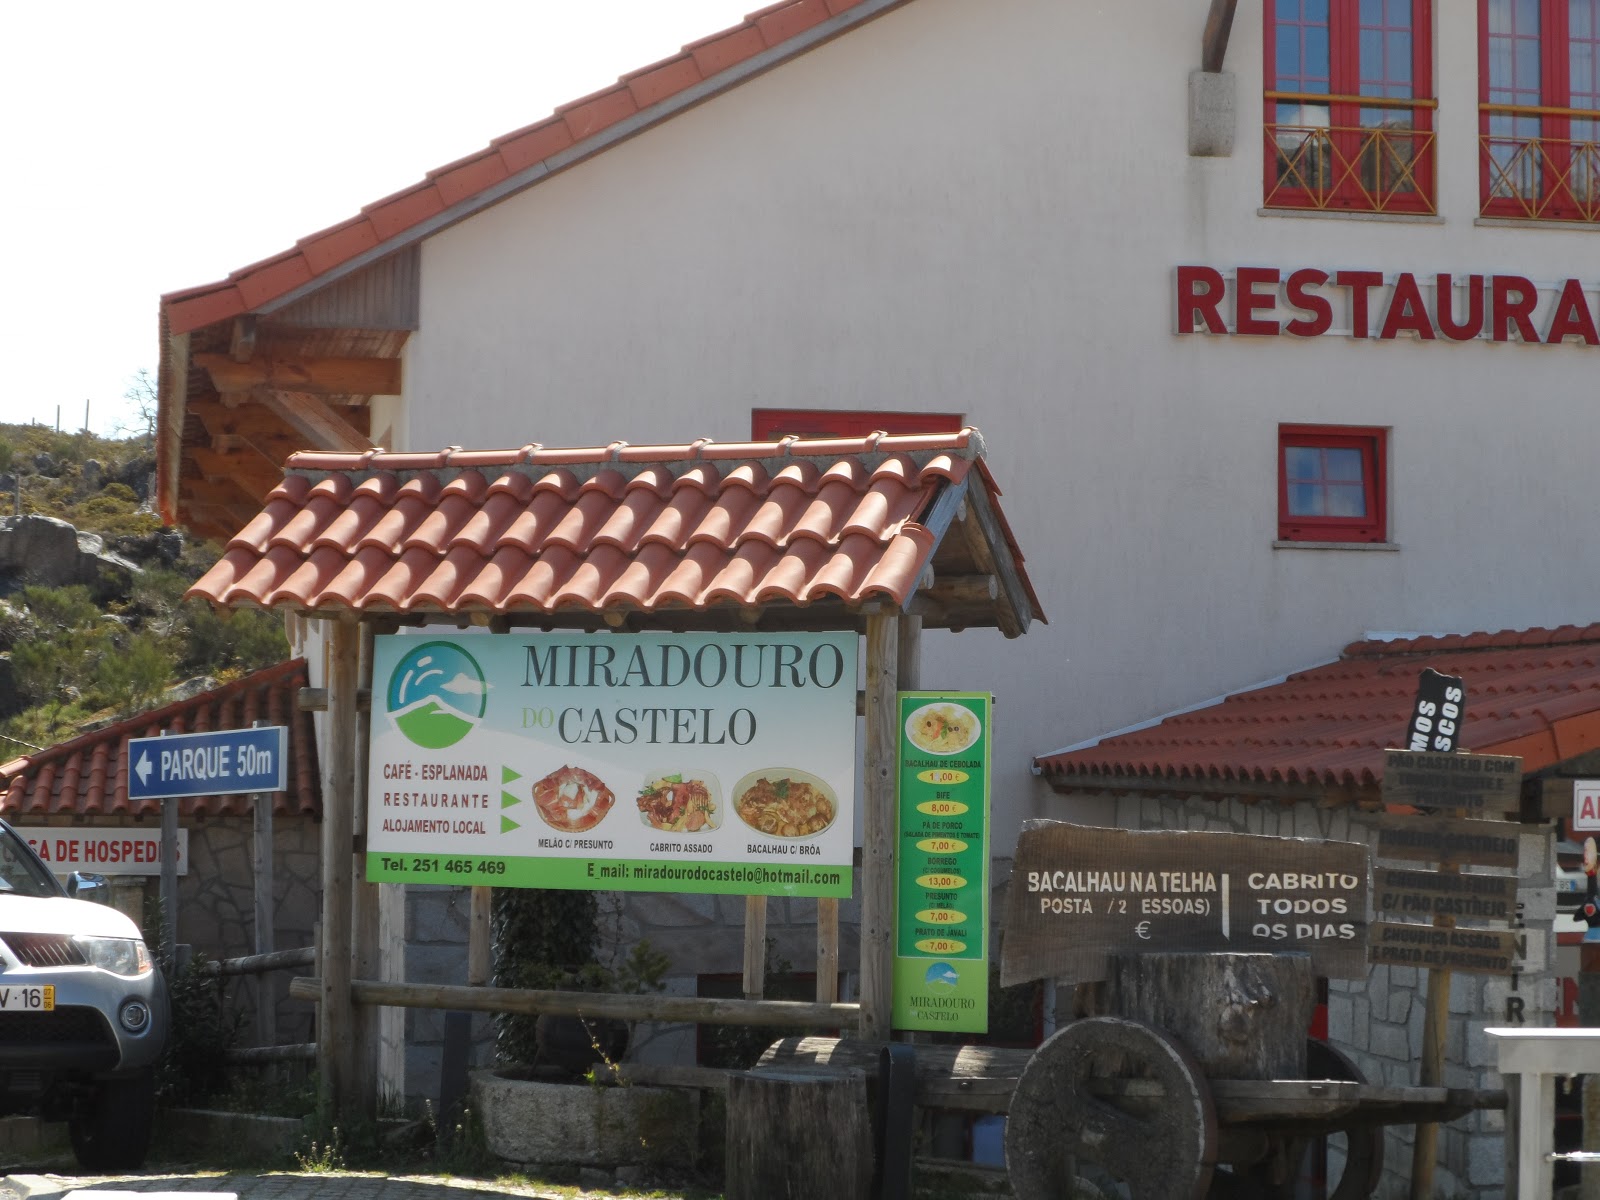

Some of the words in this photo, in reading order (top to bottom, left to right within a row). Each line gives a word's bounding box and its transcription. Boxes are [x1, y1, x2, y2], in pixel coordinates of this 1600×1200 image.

[1177, 265, 1600, 345] RESTAURA
[520, 643, 844, 688] MIRADOURO
[521, 707, 555, 729] DO
[557, 707, 757, 745] CASTELO
[161, 745, 230, 782] PARQUE
[237, 744, 272, 777] 50m
[383, 760, 412, 780] CAFÉ
[421, 764, 488, 781] ESPLANADA
[1484, 760, 1515, 774] COM
[383, 792, 488, 809] RESTAURANTE
[935, 791, 950, 799] BIFE
[931, 803, 950, 813] 8,00
[382, 819, 450, 834] ALOJAMENTO
[453, 821, 486, 835] LOCAL
[56, 839, 79, 862] DE
[84, 840, 180, 863] HOSPED
[538, 837, 563, 849] MELÃO
[574, 839, 614, 850] PRESUNTO
[649, 842, 682, 853] CABRITO
[683, 843, 713, 854] ASSADO
[747, 844, 788, 855] BACALHAU
[799, 844, 821, 856] BRÔA
[931, 841, 949, 851] 7,00
[381, 857, 408, 872] Tel.
[412, 858, 439, 873] 251
[444, 859, 472, 874] 465
[477, 860, 506, 875] 469
[927, 857, 957, 866] BORREGO
[633, 864, 840, 885] miradourodocastelo@hotmail.com
[929, 877, 951, 887] 13,00
[1028, 871, 1125, 893] BACALHAU
[1130, 872, 1157, 893] NA
[1160, 872, 1217, 893] TELHA
[1248, 872, 1359, 890] CABRITO
[925, 892, 958, 901] PRESUNTO
[1040, 898, 1093, 914] POSTA
[1257, 899, 1348, 915] TODOS
[930, 912, 949, 922] 7,00
[915, 928, 935, 936] PRATO
[937, 928, 945, 937] DE
[1134, 921, 1151, 940] €
[1252, 923, 1288, 941] OS
[1296, 923, 1356, 940] DIAS
[929, 941, 948, 951] 7,00
[910, 996, 975, 1009] MIRADOURO
[917, 1011, 959, 1021] CASTELO
